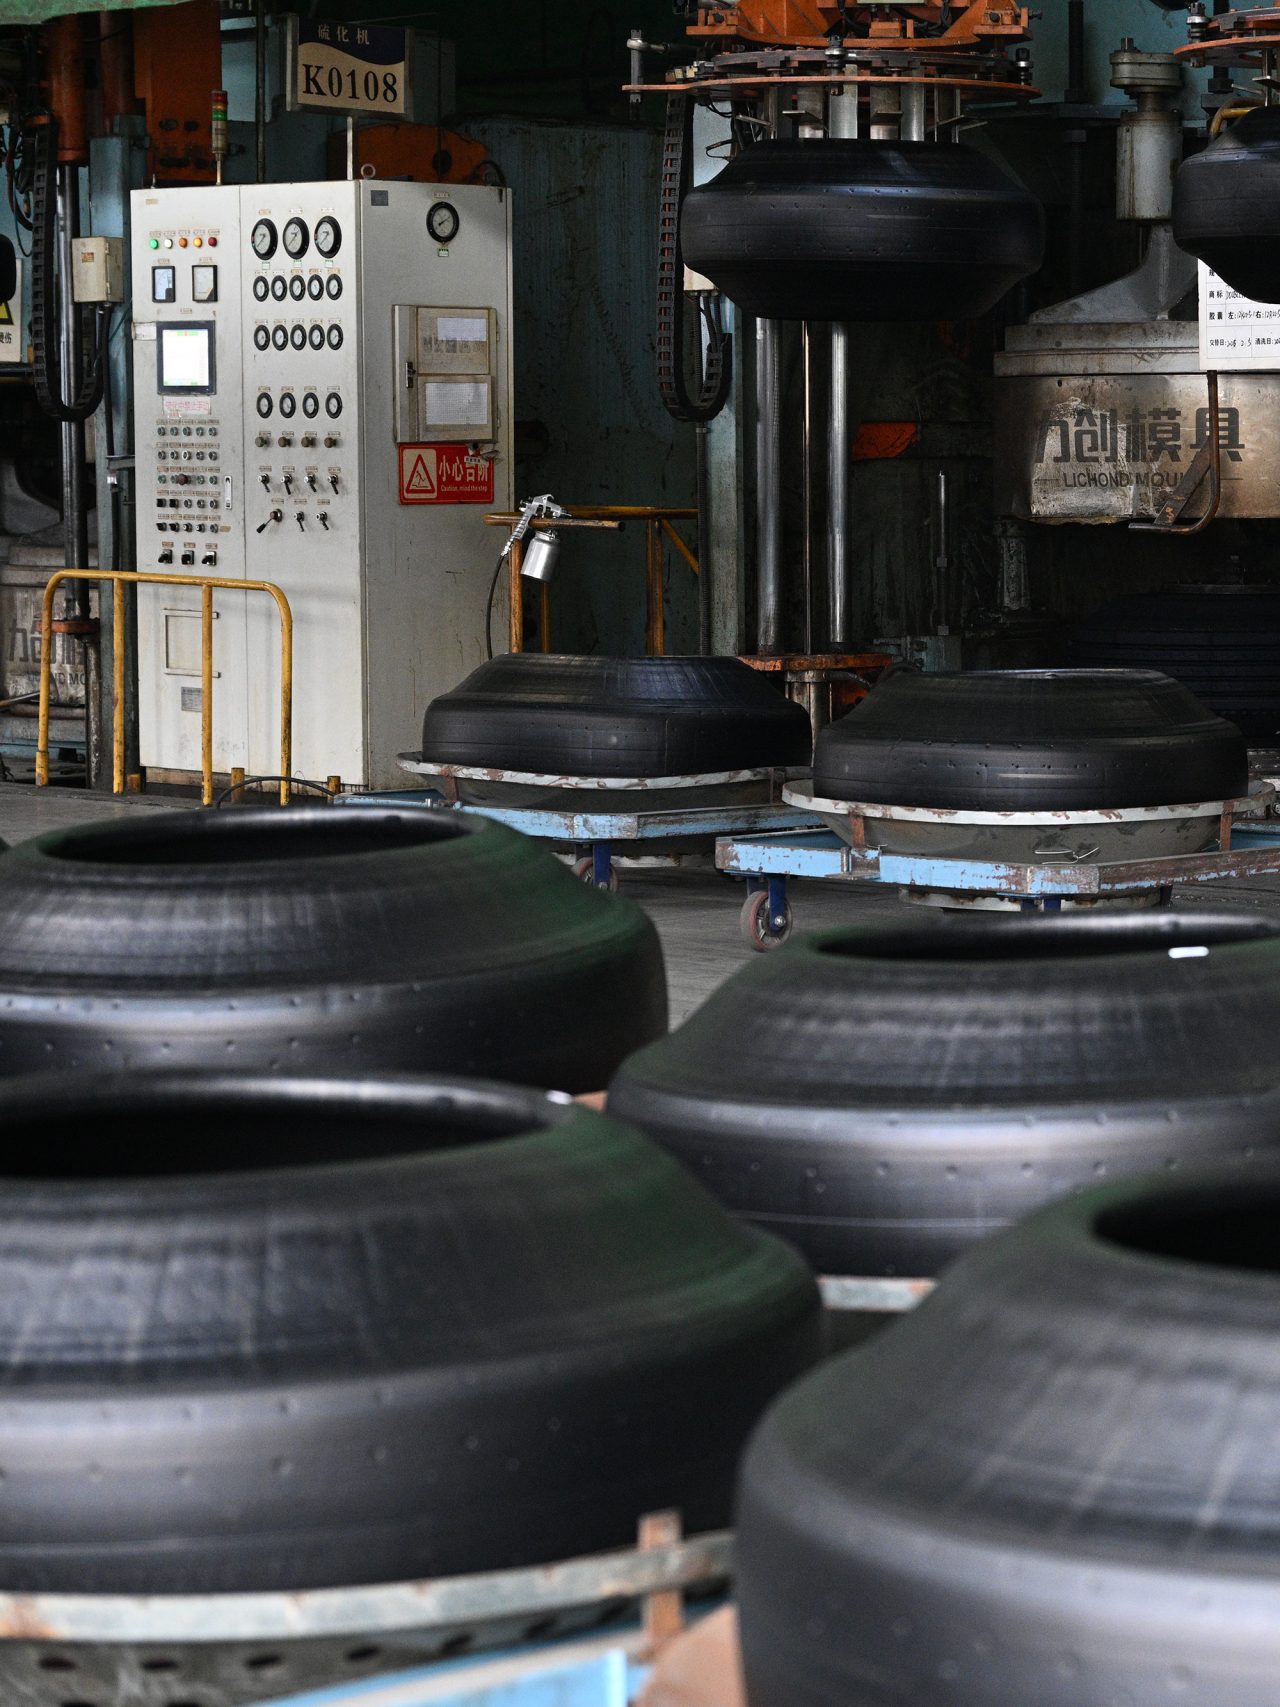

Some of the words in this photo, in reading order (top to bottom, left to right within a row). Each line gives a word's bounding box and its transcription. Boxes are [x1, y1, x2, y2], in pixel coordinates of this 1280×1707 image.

[318, 24, 370, 45] 硫化机
[302, 64, 398, 103] K0108
[1062, 472, 1130, 488] LICHOND
